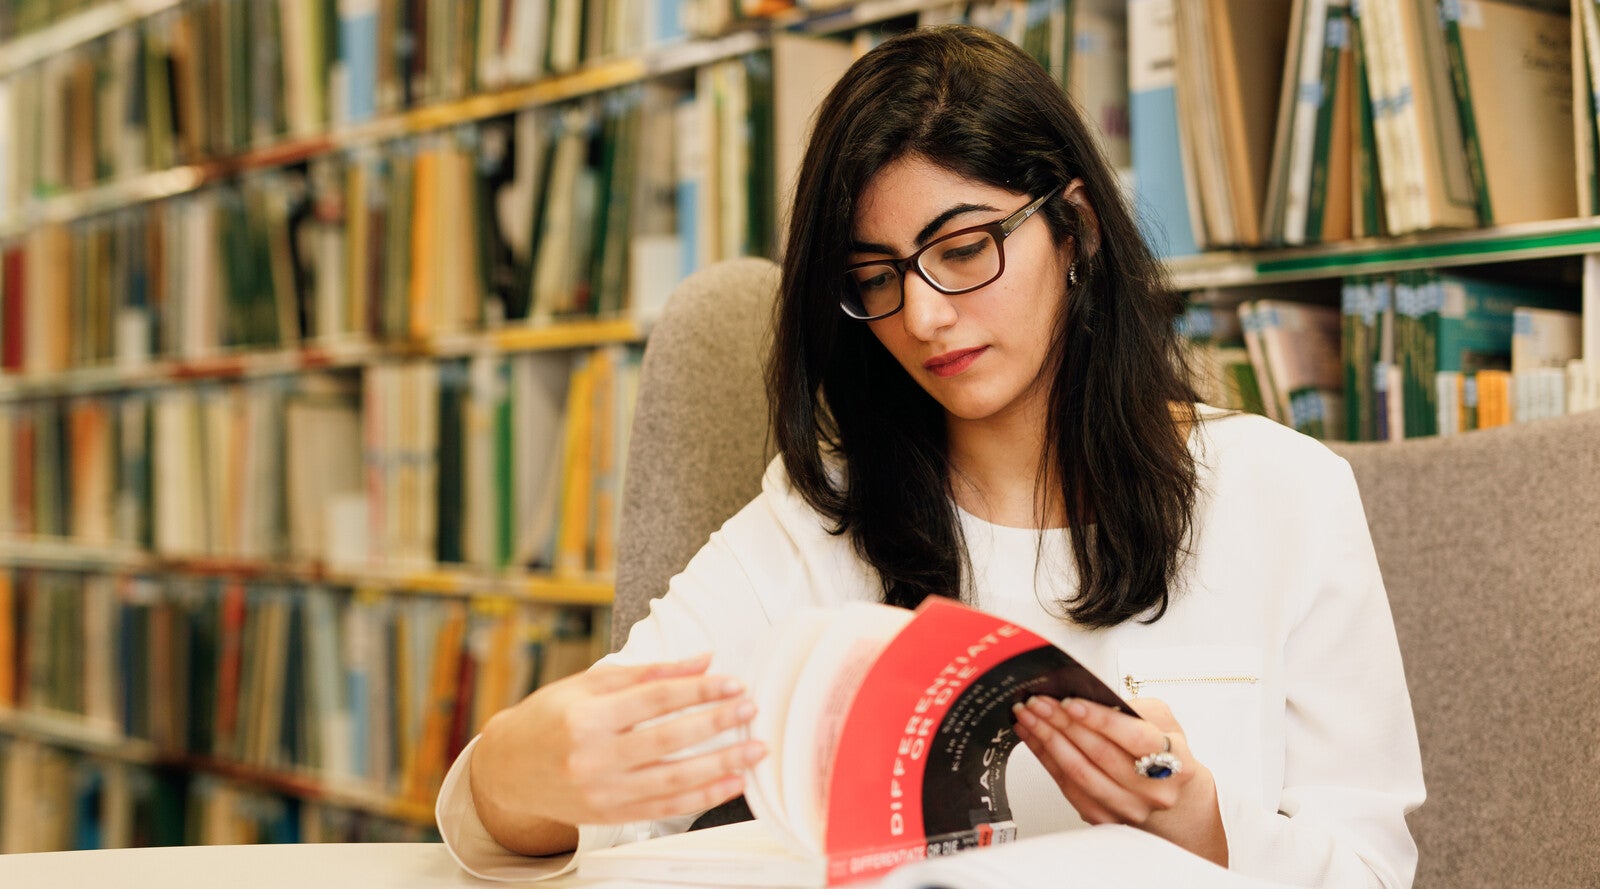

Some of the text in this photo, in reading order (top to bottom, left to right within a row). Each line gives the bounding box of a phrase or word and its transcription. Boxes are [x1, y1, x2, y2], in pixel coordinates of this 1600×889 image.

[890, 624, 1021, 836] DIFFERENTIATE
[910, 666, 979, 761] OR DIE
[980, 728, 1011, 811] JACK
[850, 844, 926, 874] DIFFERENTIATE
